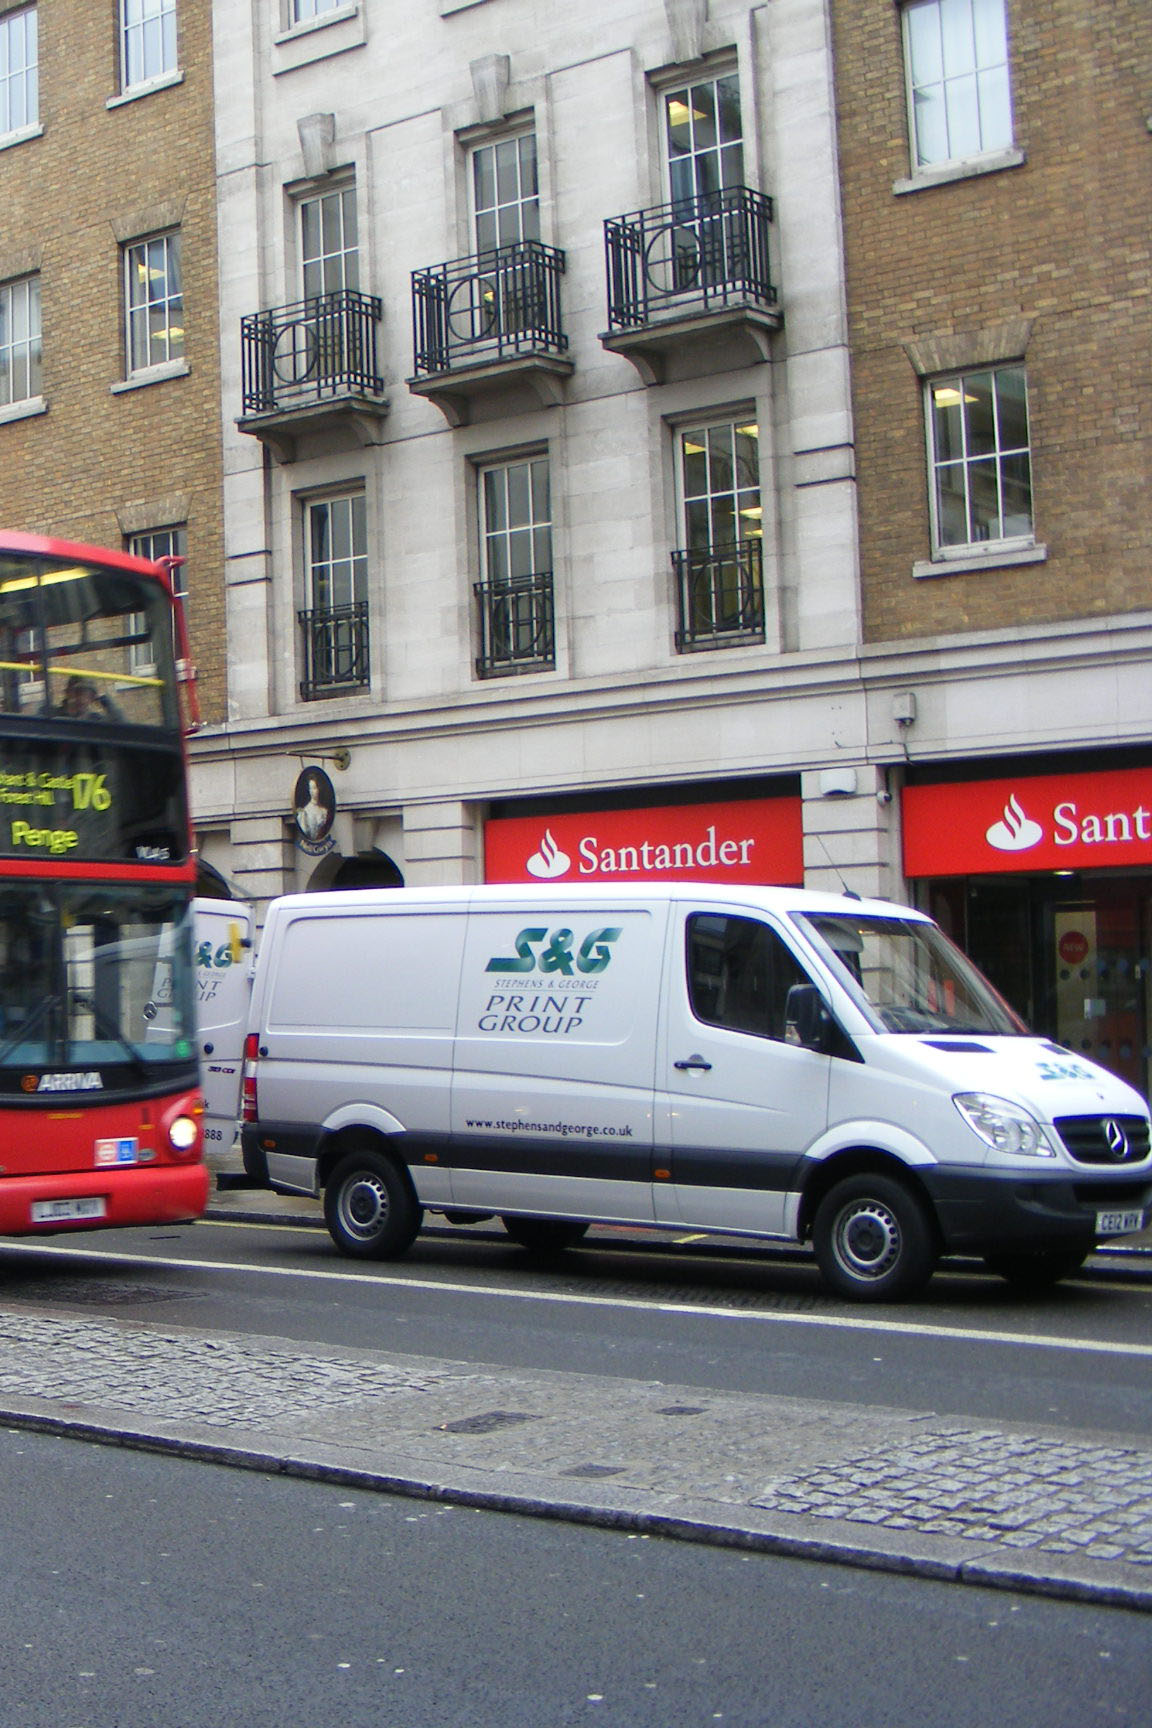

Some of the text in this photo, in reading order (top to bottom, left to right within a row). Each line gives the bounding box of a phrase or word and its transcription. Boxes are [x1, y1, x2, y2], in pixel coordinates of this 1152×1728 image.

[72, 773, 112, 812] 176
[11, 820, 79, 854] Penge
[578, 826, 755, 875] Santander
[193, 941, 233, 968] &G
[485, 927, 624, 976] S&G
[494, 978, 599, 990] STEPHENS & GEORGE
[485, 994, 593, 1014] PRINT
[478, 1014, 583, 1034] GROUP
[37, 1071, 104, 1092] ARRIVA
[465, 1118, 634, 1138] www.stephensandgeorge.co.uk
